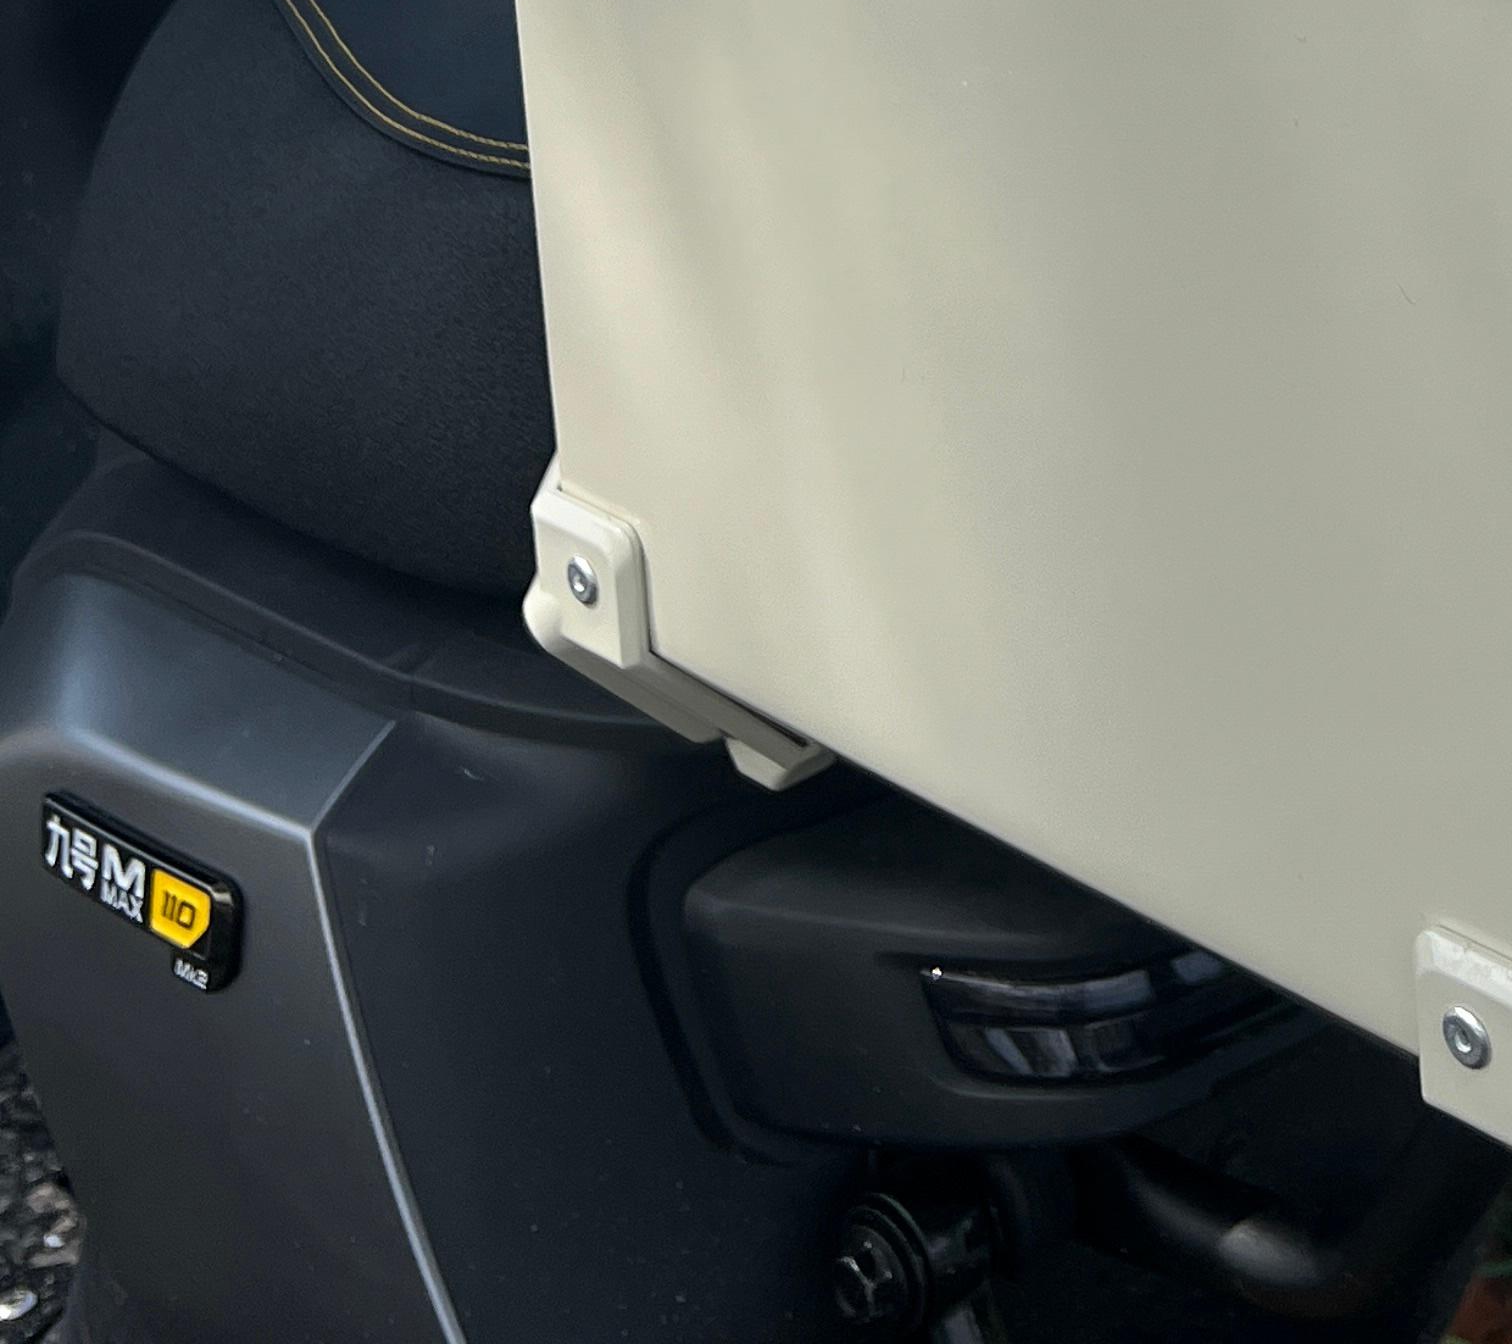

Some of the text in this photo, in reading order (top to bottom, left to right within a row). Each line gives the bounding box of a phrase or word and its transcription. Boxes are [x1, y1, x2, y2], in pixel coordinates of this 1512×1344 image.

[45, 814, 146, 899] 九号 M
[101, 879, 143, 923] MAX
[162, 890, 196, 930] 110
